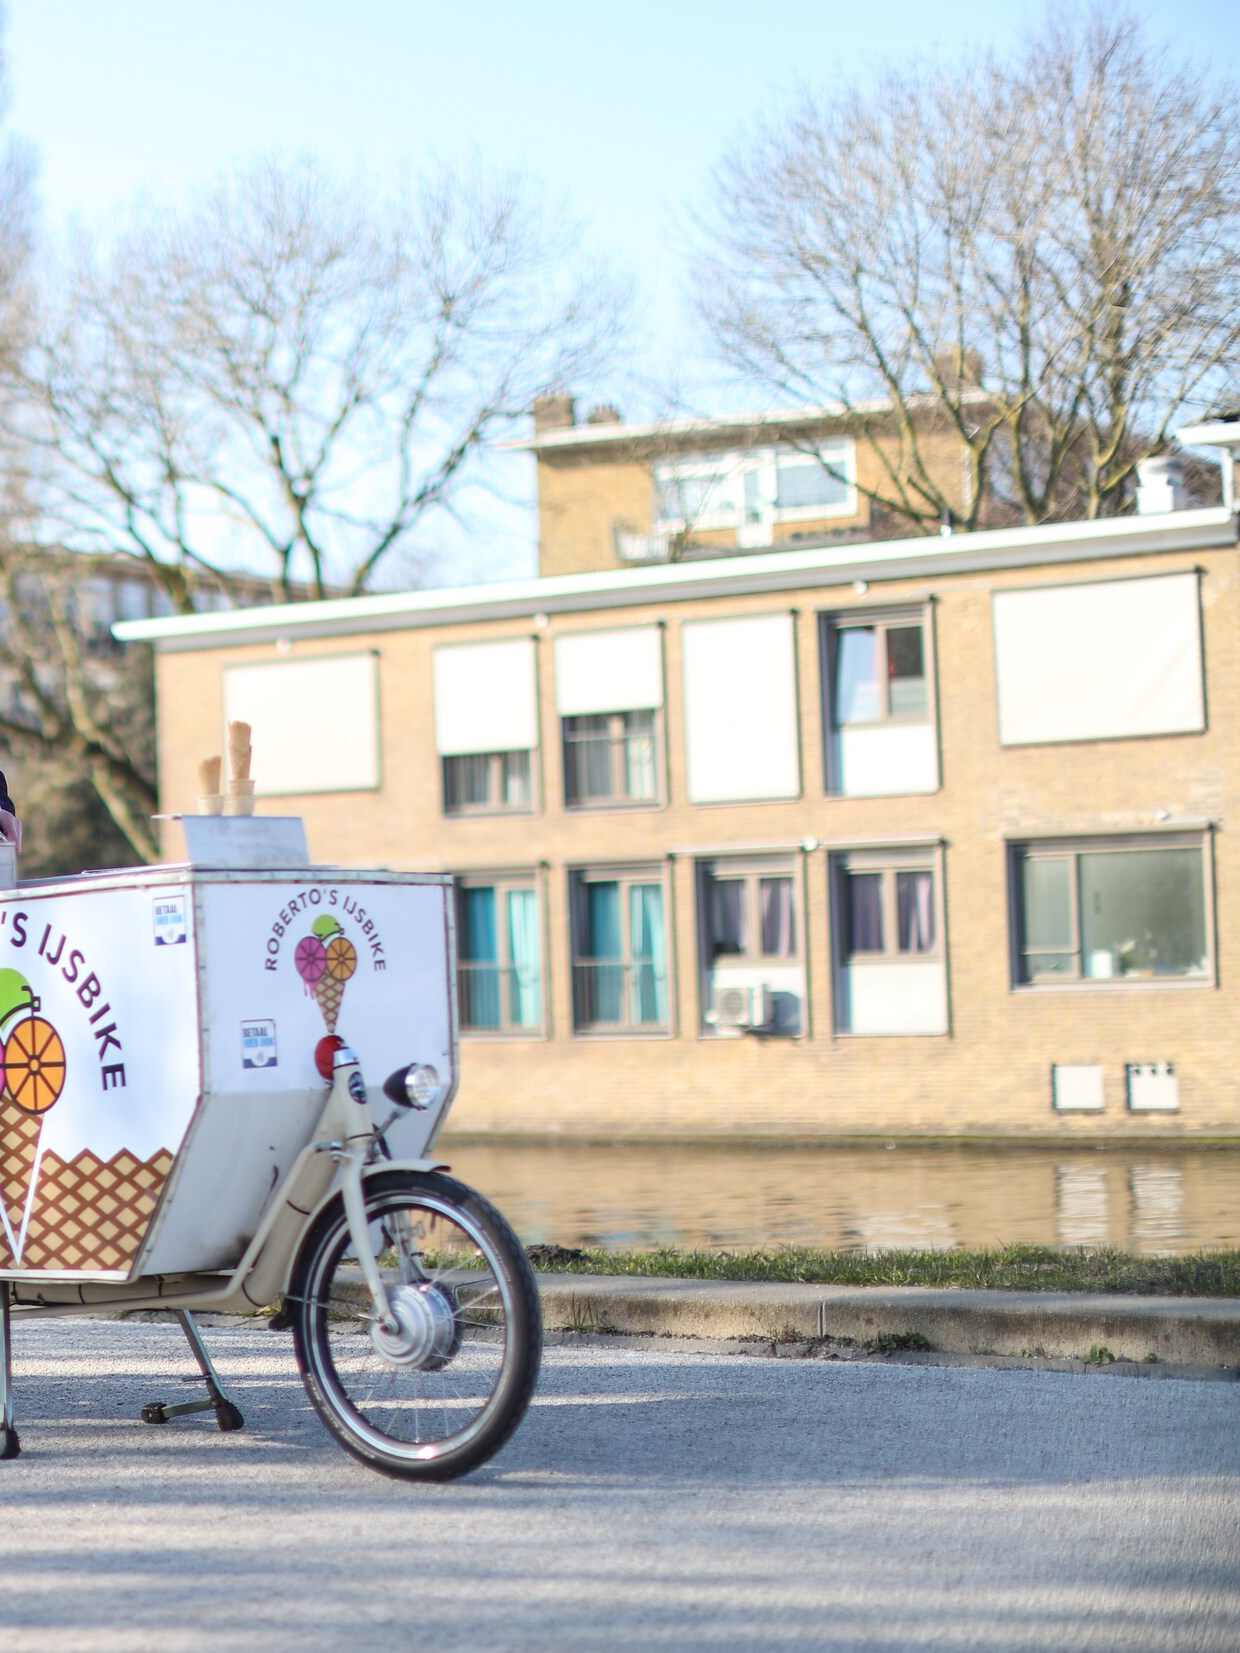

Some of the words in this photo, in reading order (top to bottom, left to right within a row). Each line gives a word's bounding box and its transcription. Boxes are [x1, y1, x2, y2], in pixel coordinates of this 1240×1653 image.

[265, 888, 338, 971] ROBERTO'S
[343, 896, 386, 971] IJSBIKE
[38, 923, 127, 1091] IJSBIKE
